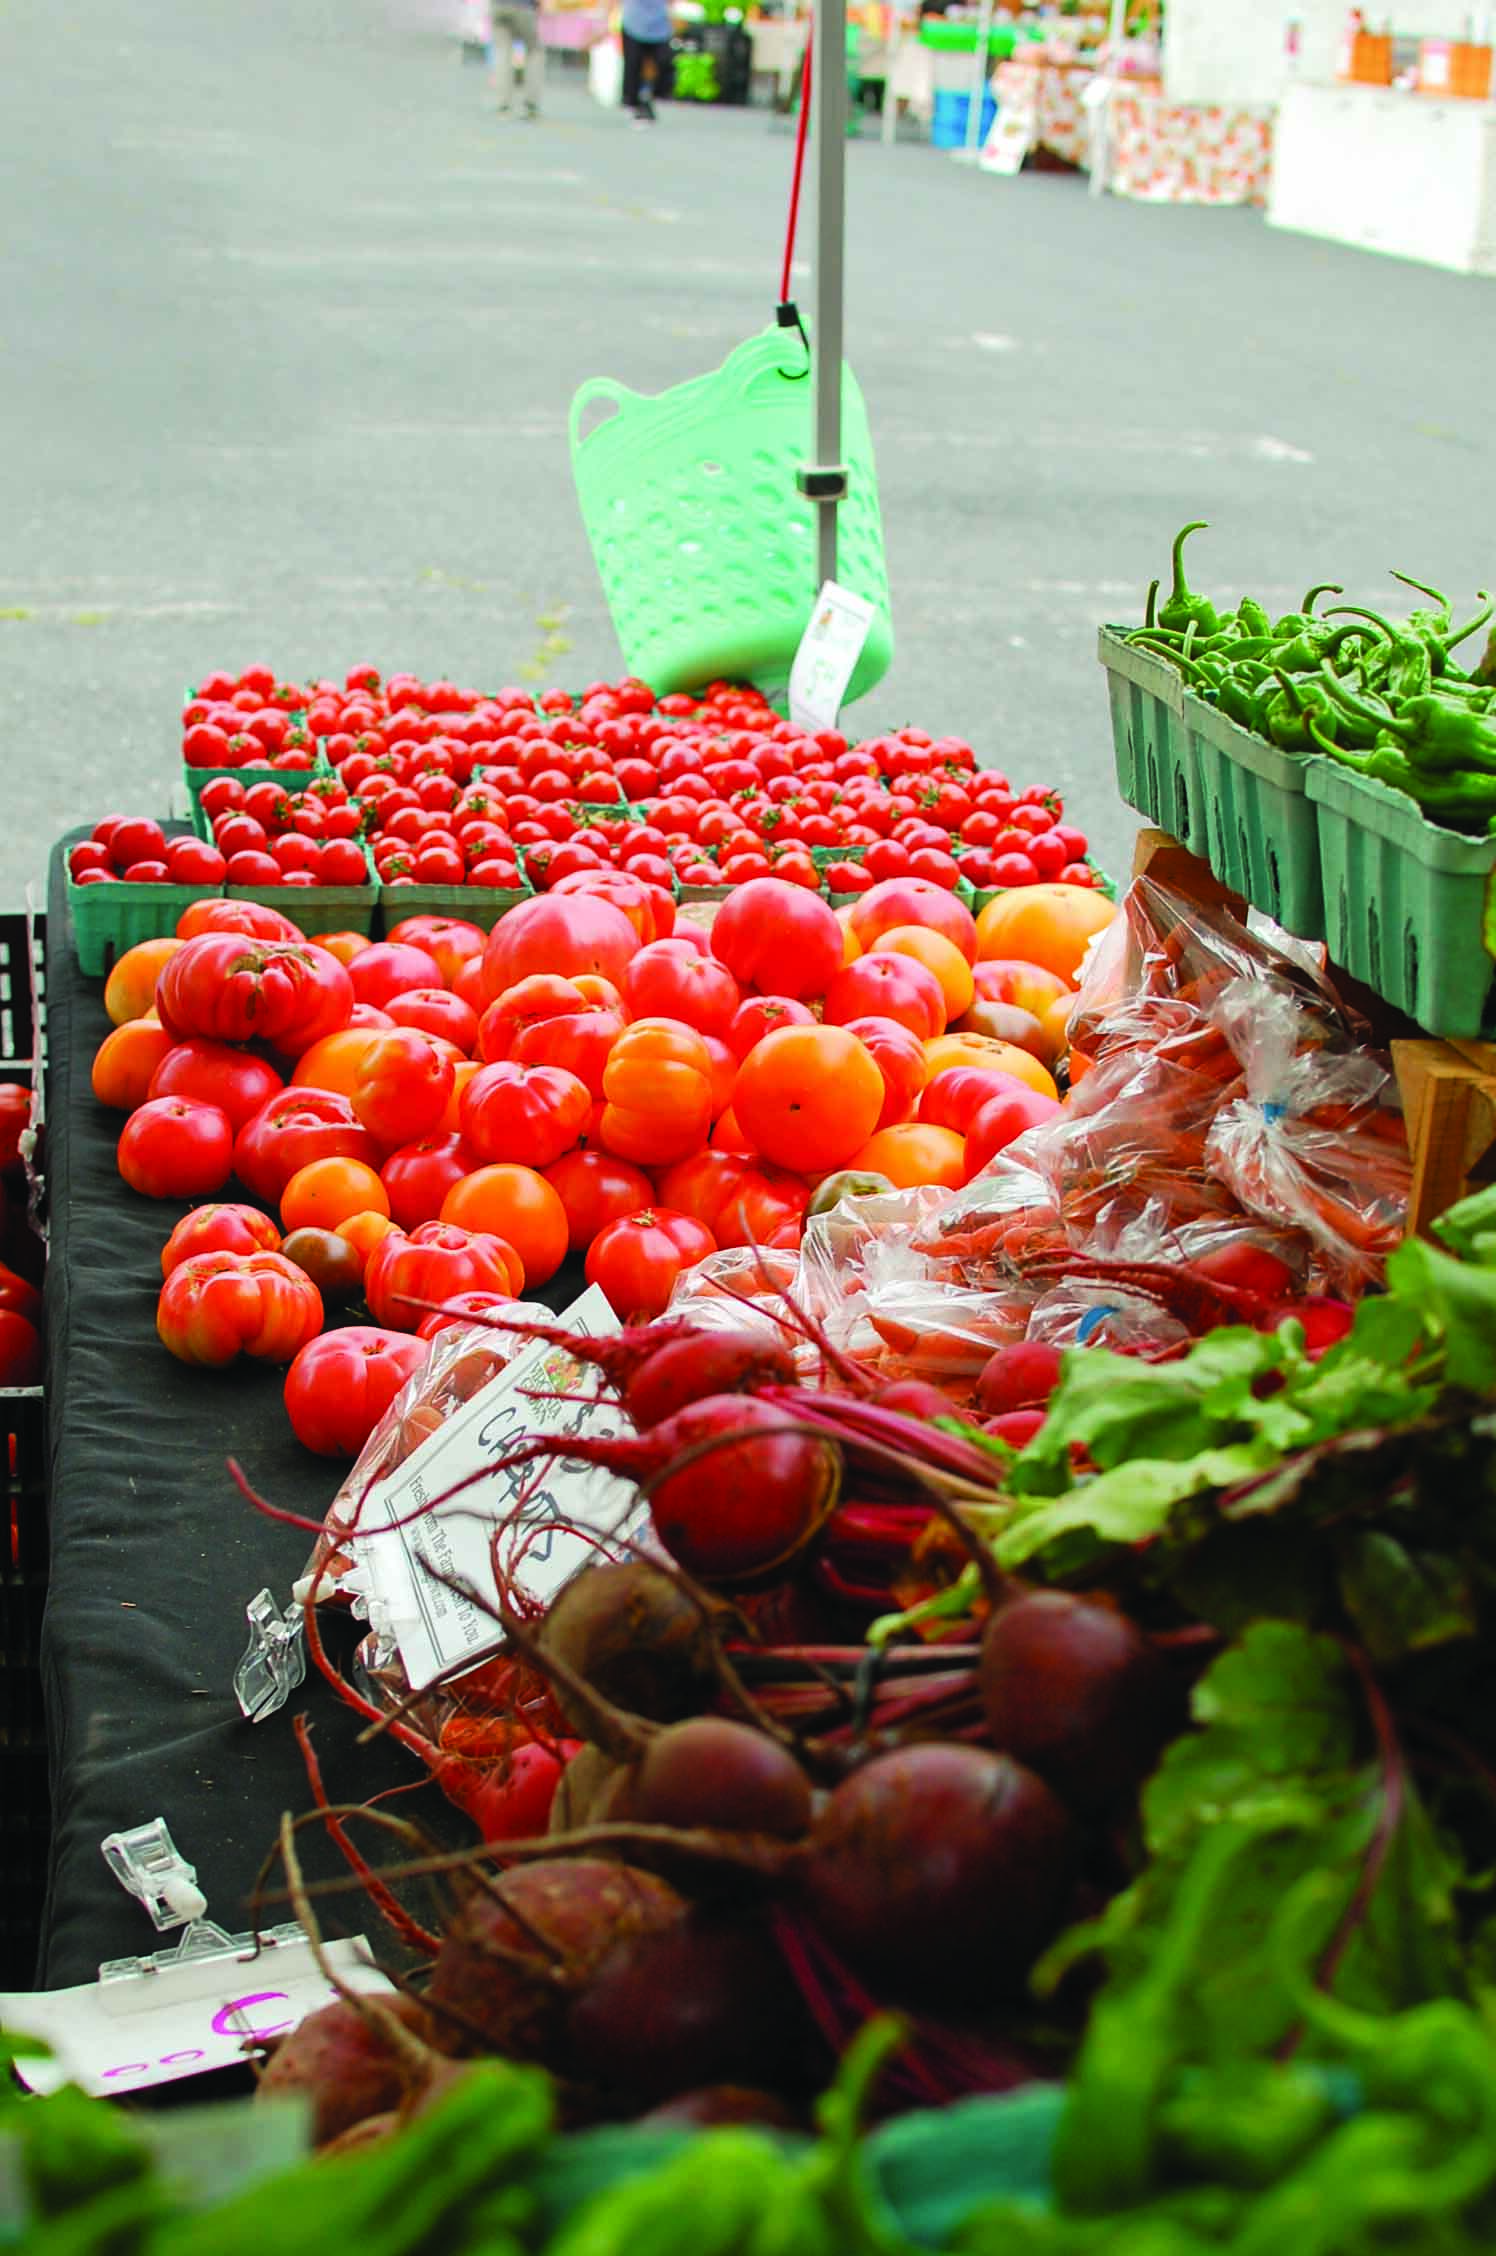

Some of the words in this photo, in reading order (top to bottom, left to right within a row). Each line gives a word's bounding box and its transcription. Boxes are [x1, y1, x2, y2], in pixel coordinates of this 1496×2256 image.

[409, 1474, 431, 1509] Fresh
[431, 1530, 448, 1553] The
[457, 1601, 475, 1622] To
